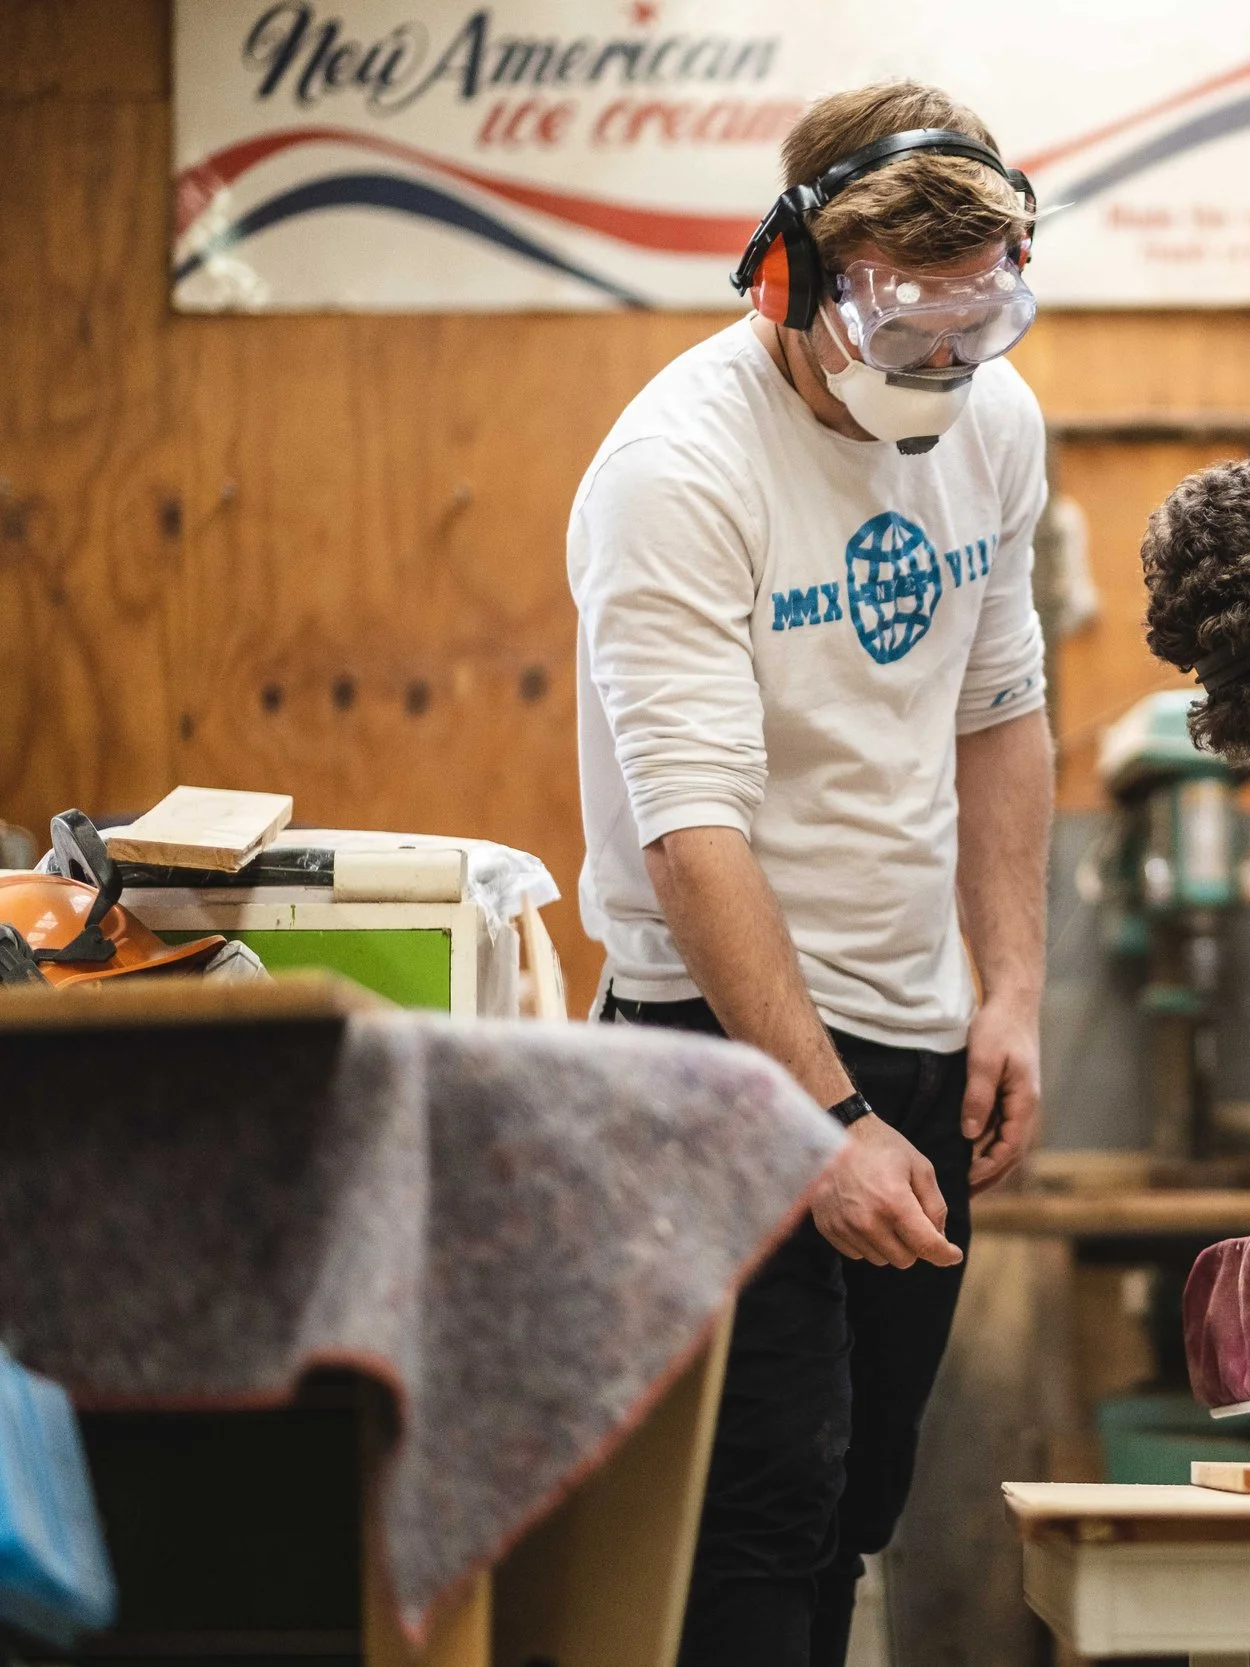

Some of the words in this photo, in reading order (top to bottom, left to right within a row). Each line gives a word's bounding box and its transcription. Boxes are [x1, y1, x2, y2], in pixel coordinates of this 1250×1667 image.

[242, 0, 428, 108] New
[396, 4, 780, 108] American
[476, 98, 578, 149] ice
[771, 581, 843, 631] MMX
